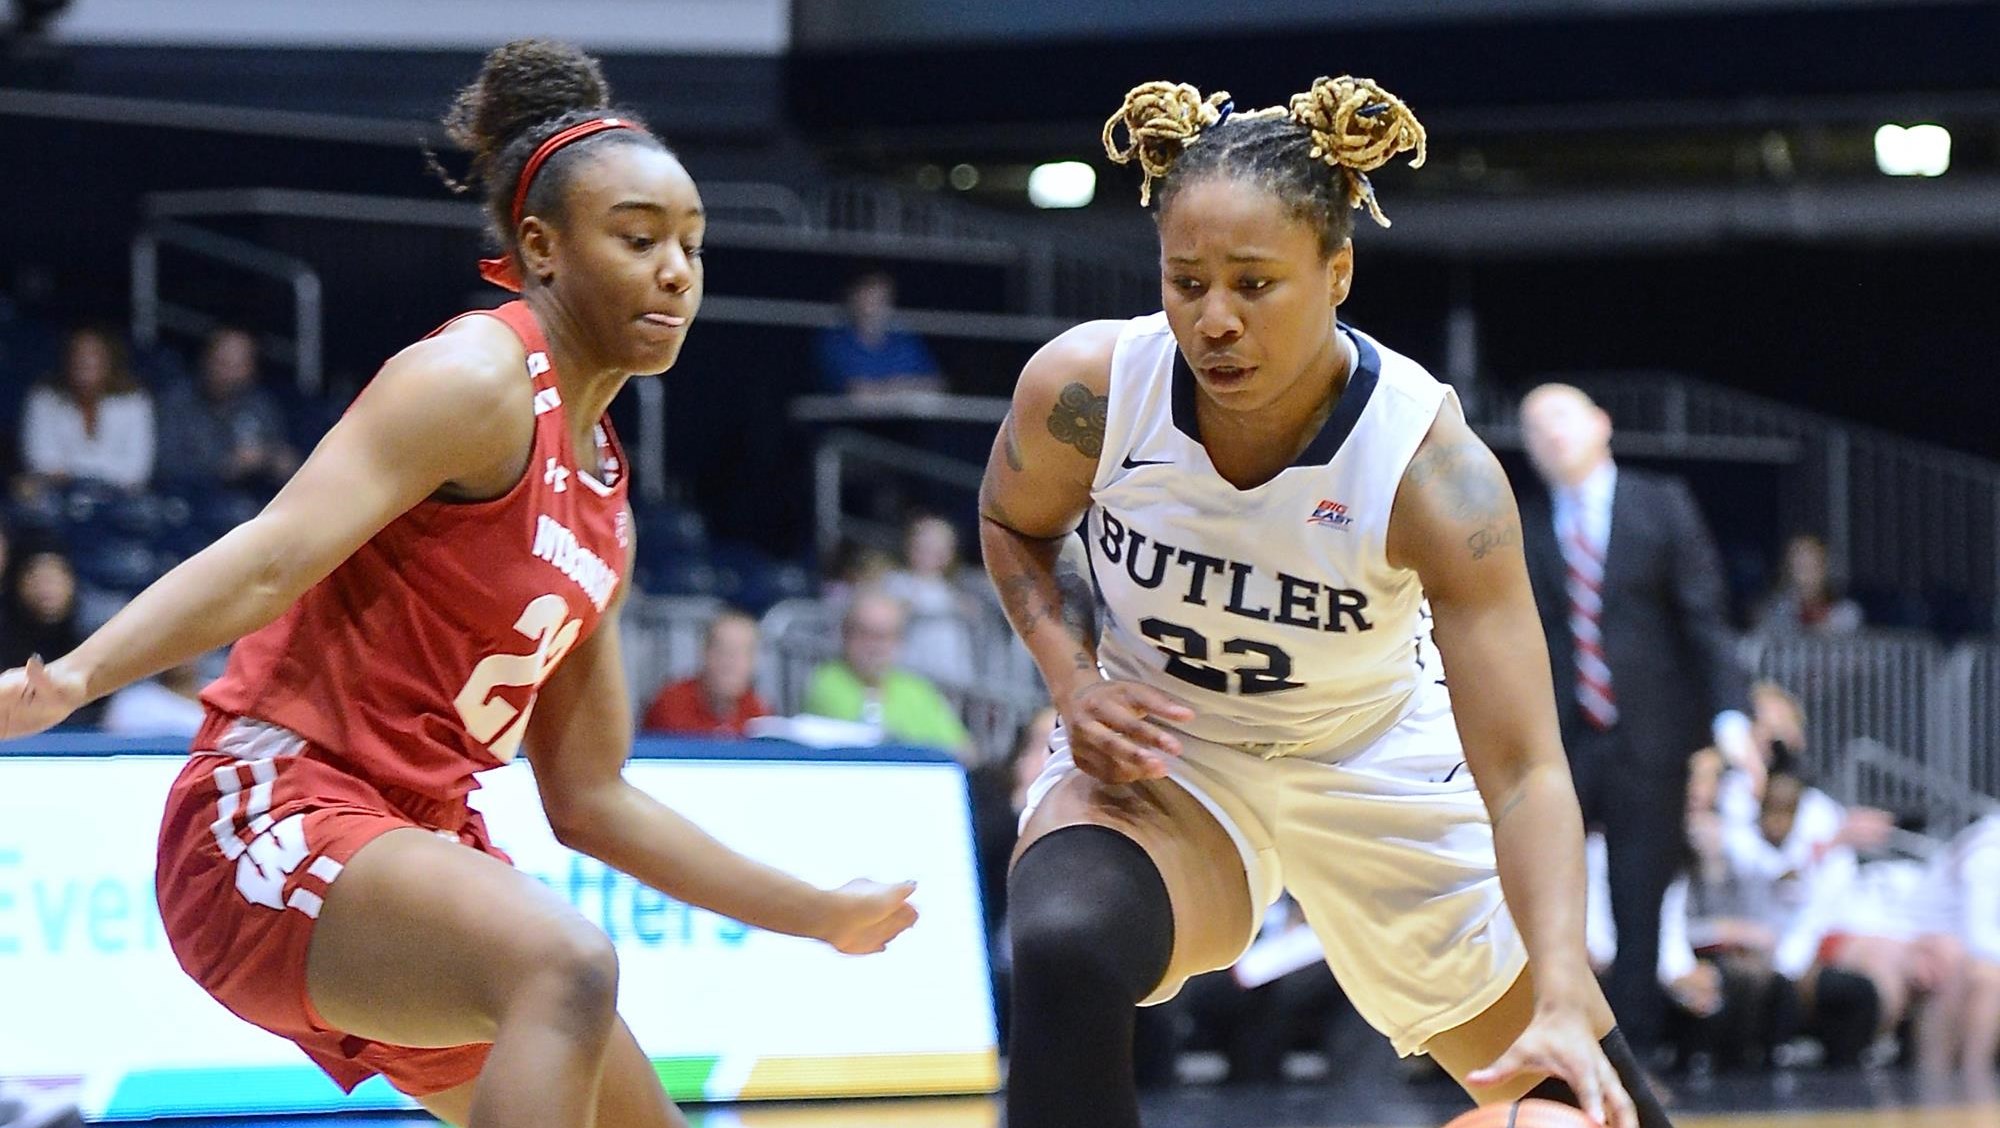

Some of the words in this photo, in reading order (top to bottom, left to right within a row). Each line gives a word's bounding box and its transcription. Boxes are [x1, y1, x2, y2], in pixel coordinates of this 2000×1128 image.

[1311, 509, 1354, 526] EAST
[1099, 506, 1373, 632] BUTLER
[1138, 617, 1307, 695] 22
